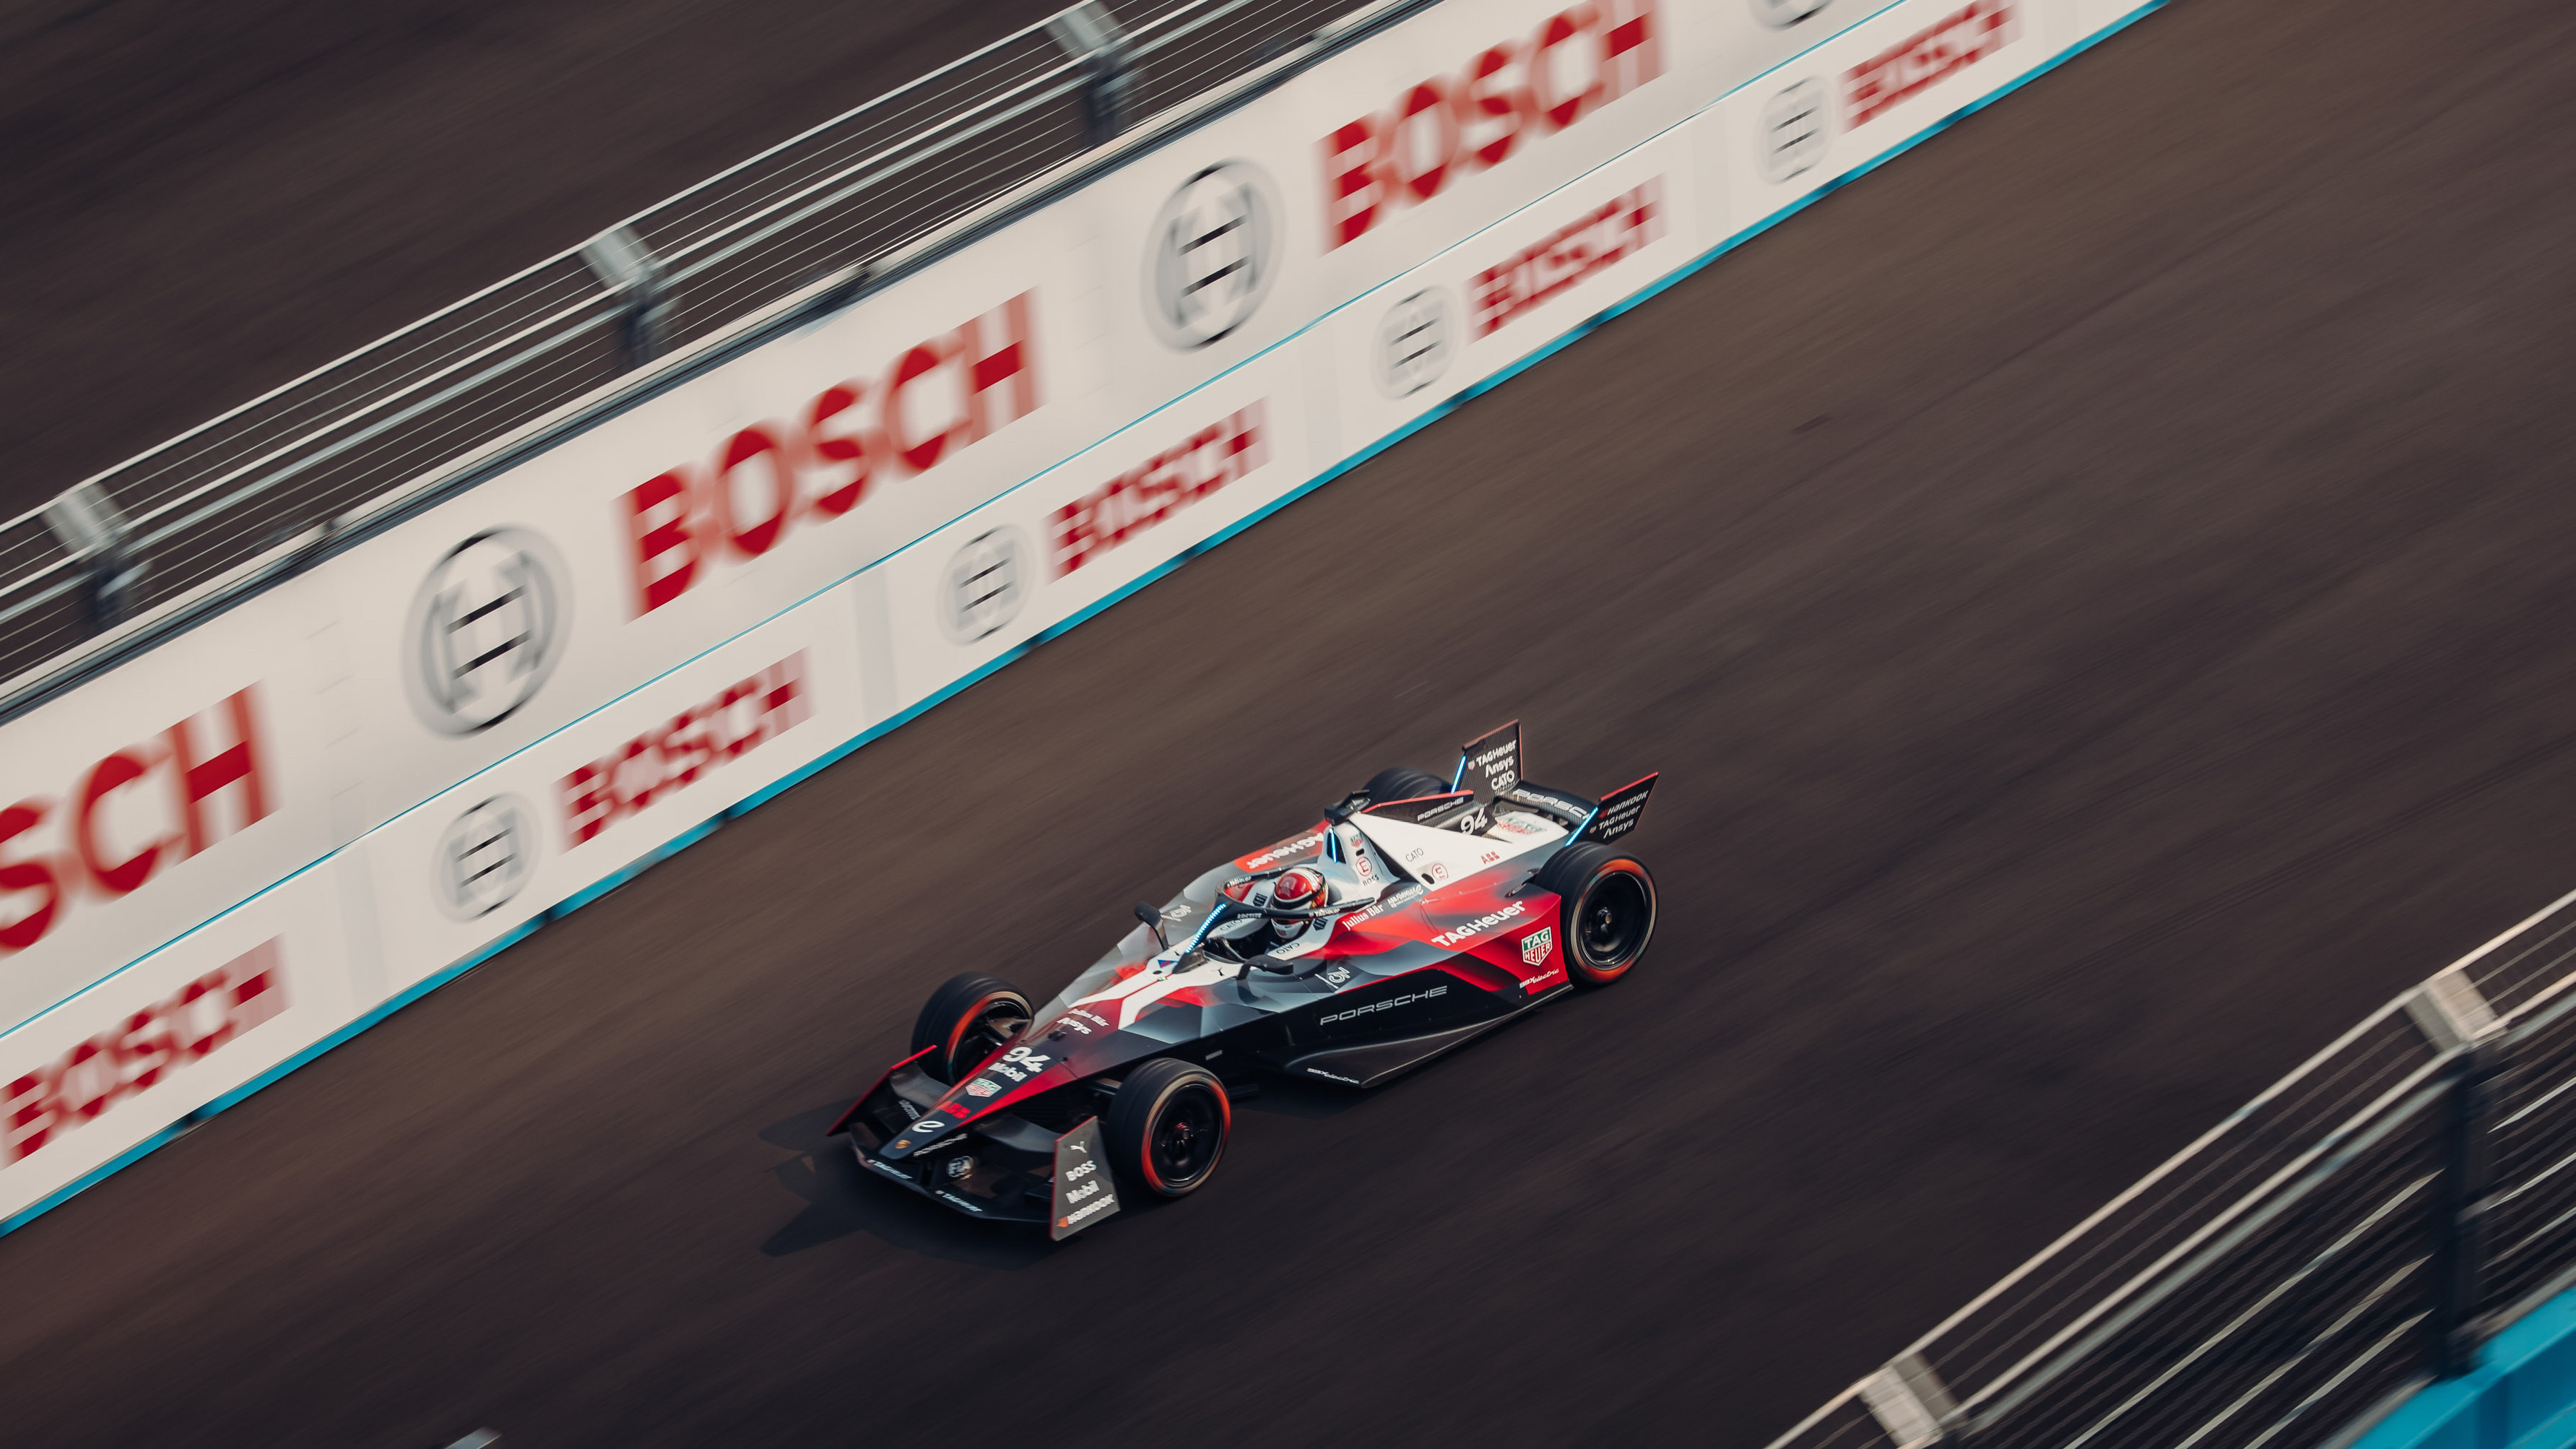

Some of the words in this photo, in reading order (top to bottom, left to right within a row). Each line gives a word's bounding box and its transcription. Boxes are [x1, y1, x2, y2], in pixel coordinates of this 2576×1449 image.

[1314, 0, 1668, 256] BOSCH
[610, 284, 1049, 626] BOSCH
[551, 646, 816, 855] BOSCH
[1486, 756, 1514, 778] Ansys
[1491, 770, 1514, 791] CATO
[1418, 797, 1464, 821] PORSCHE
[1513, 788, 1590, 819] PORSC
[1460, 808, 1488, 835] 94
[1603, 819, 1634, 839] Ansys
[1405, 847, 1424, 862] CATO
[1481, 851, 1500, 865] ABB
[1342, 912, 1368, 931] Julius
[1367, 904, 1384, 920] Bär
[1276, 943, 1300, 954] CATO
[1525, 930, 1549, 949] TAG
[1525, 942, 1551, 963] HEUER
[1320, 986, 1447, 1026] PORSCHE
[1057, 1017, 1092, 1035] Ansys
[0, 931, 294, 1171] BOSCH
[1002, 1047, 1051, 1073] 94
[987, 1063, 1028, 1082] Mobil
[1065, 1160, 1096, 1181] BOSS
[1065, 1180, 1100, 1203] Mobil
